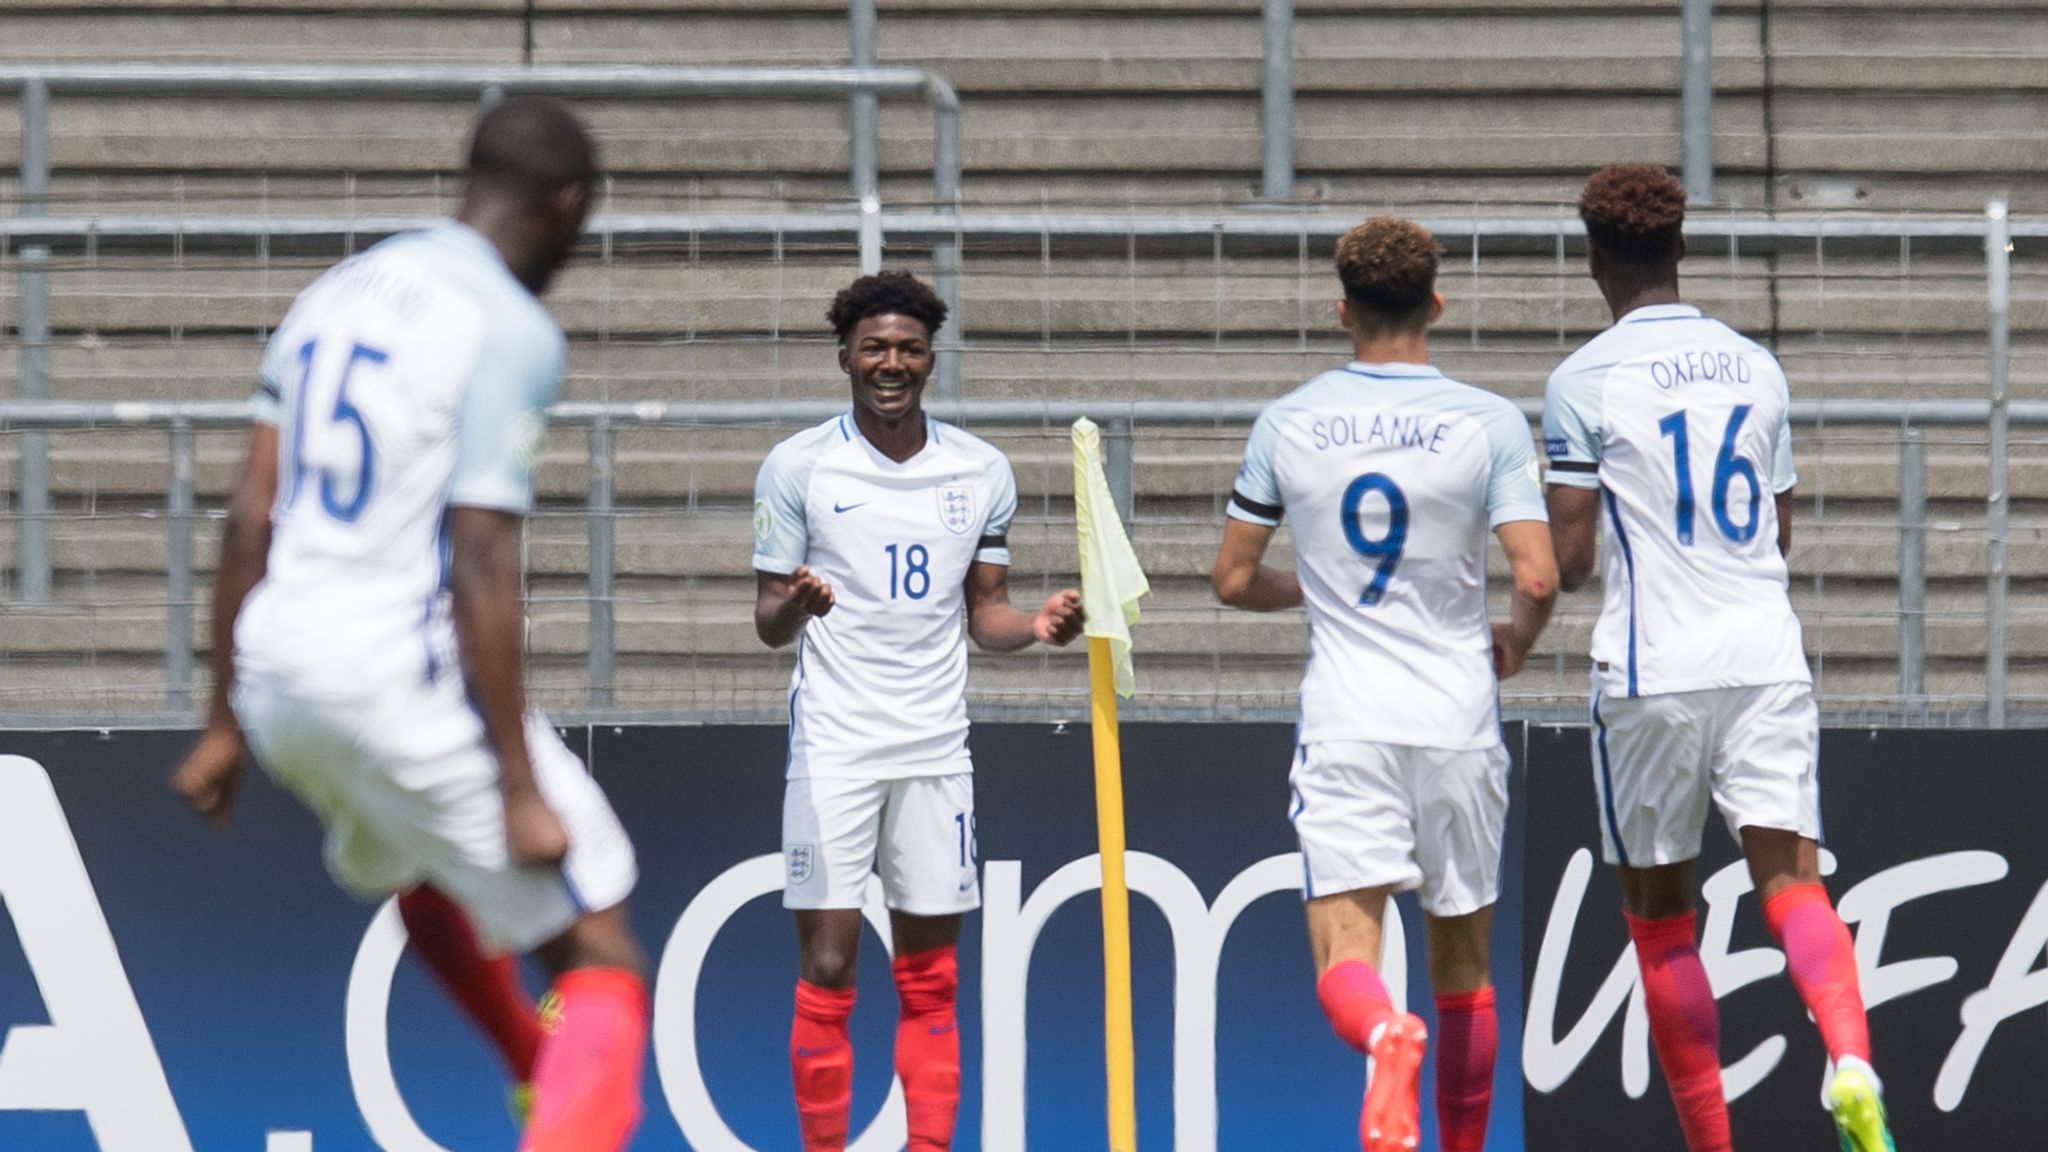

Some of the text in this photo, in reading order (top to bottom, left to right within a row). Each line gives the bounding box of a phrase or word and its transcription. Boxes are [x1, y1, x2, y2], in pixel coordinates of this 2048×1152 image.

[1651, 351, 1752, 390] OXFORD
[287, 338, 389, 522] 15
[1312, 414, 1451, 455] SOLANKE
[1658, 403, 1763, 547] 16
[884, 543, 931, 601] 18
[1339, 472, 1409, 608] 9
